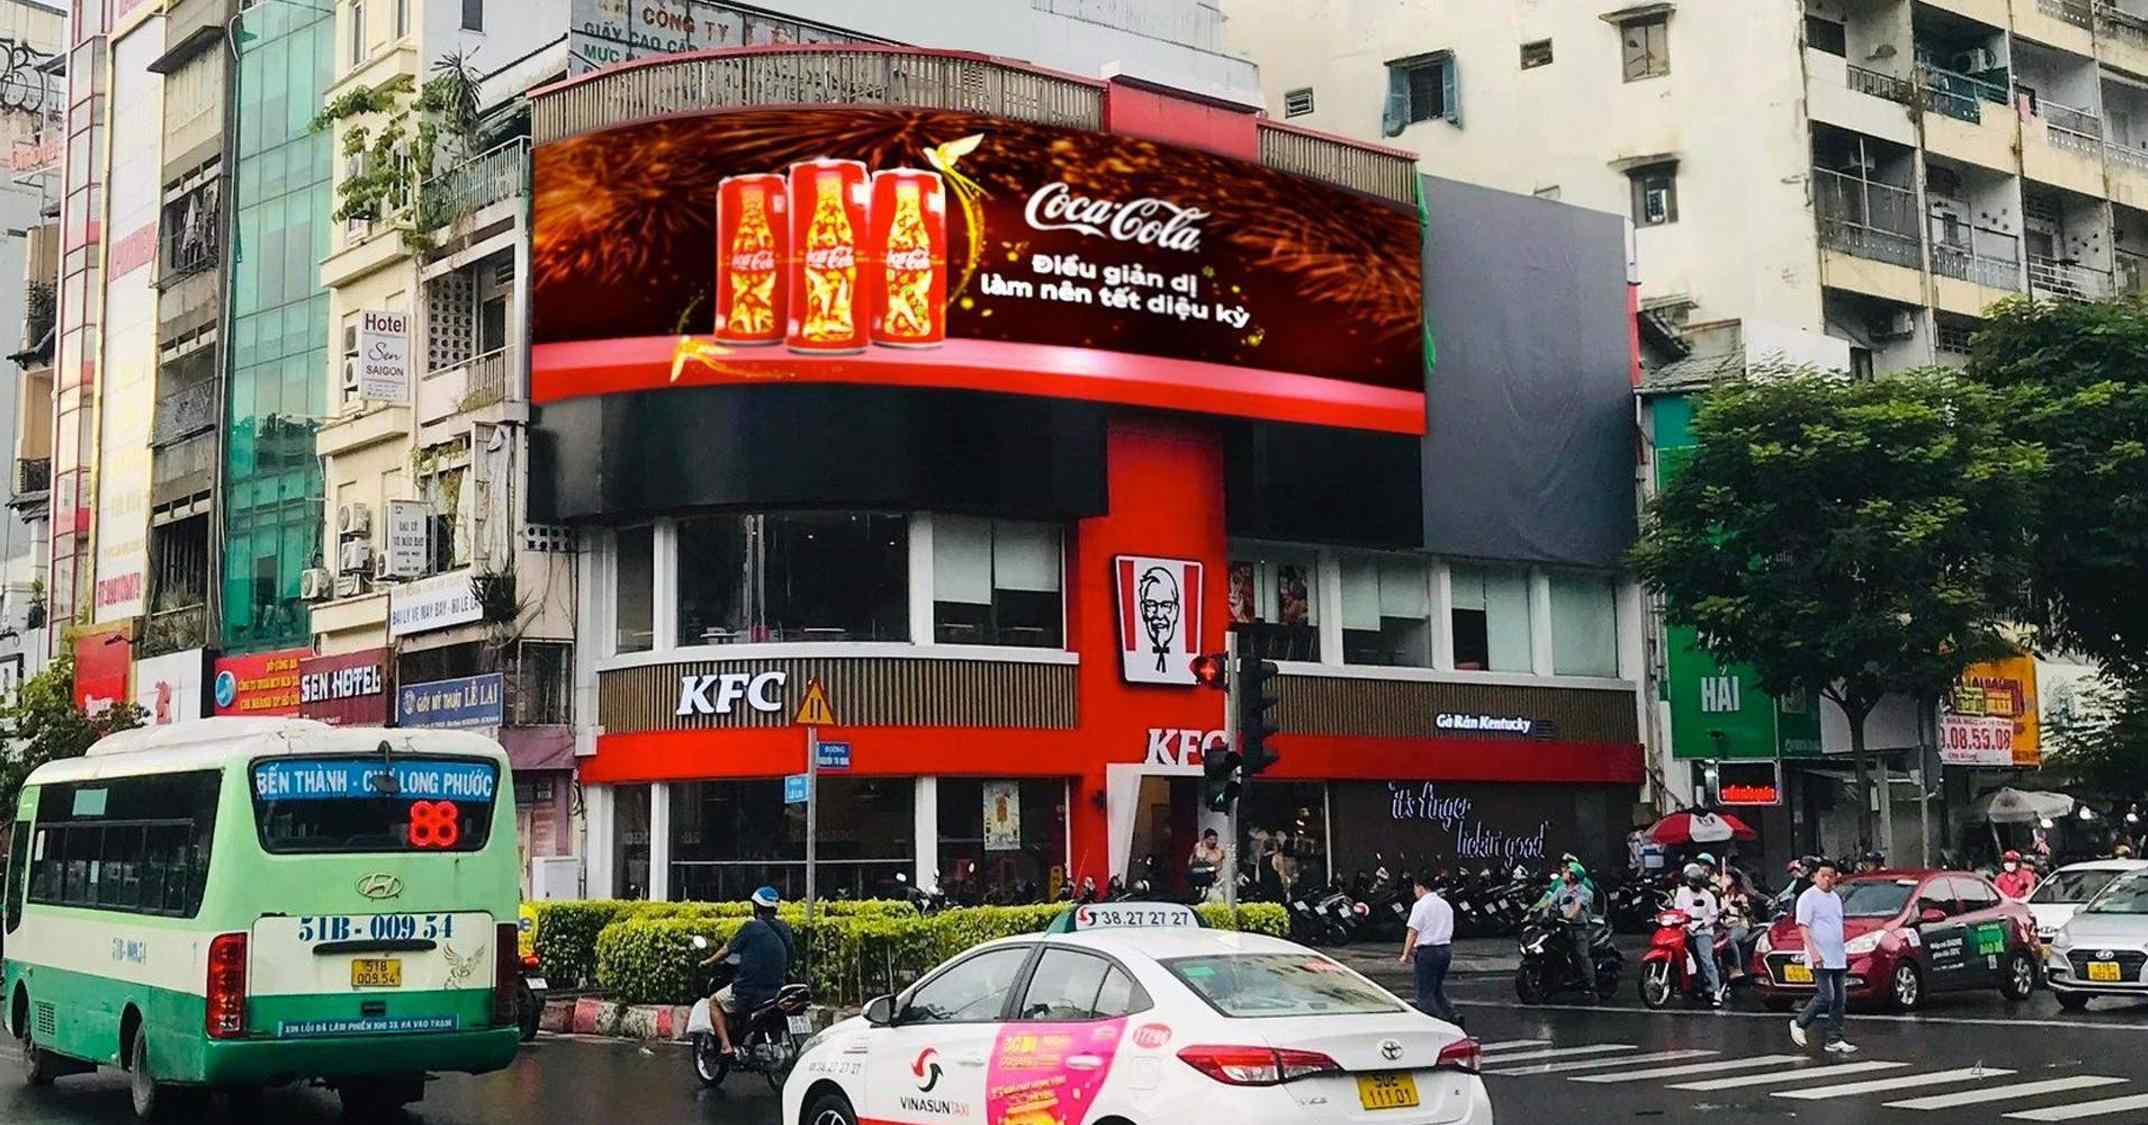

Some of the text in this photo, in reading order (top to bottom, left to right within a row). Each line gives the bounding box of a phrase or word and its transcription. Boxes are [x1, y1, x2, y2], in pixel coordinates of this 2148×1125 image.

[643, 3, 695, 34] CÔNG
[704, 20, 729, 42] TY
[1025, 182, 1211, 251] Coca-Cola
[981, 273, 1032, 297] làm
[1040, 281, 1092, 304] nên
[1099, 286, 1141, 310] tết
[1147, 294, 1209, 321] diệu
[1171, 275, 1197, 297] dị
[365, 313, 406, 333] Hotel
[368, 341, 401, 361] Sen
[366, 365, 404, 376] SAIGON
[302, 673, 328, 702] SEN
[332, 664, 381, 699] HOTEL
[464, 678, 478, 707] LÊ
[480, 683, 498, 705] LAI
[676, 671, 786, 716] KFC
[1700, 665, 1740, 711] HẢI
[1480, 714, 1531, 734] Kentucky
[256, 763, 289, 794] BẾN
[294, 763, 347, 794] THÀNH
[400, 769, 438, 795] LONG
[443, 767, 492, 797] PHƯỚC
[411, 801, 457, 847] 88
[1101, 911, 1188, 926] 38.27 27 27
[366, 960, 388, 972] 51B
[900, 1096, 951, 1116] VINASUN
